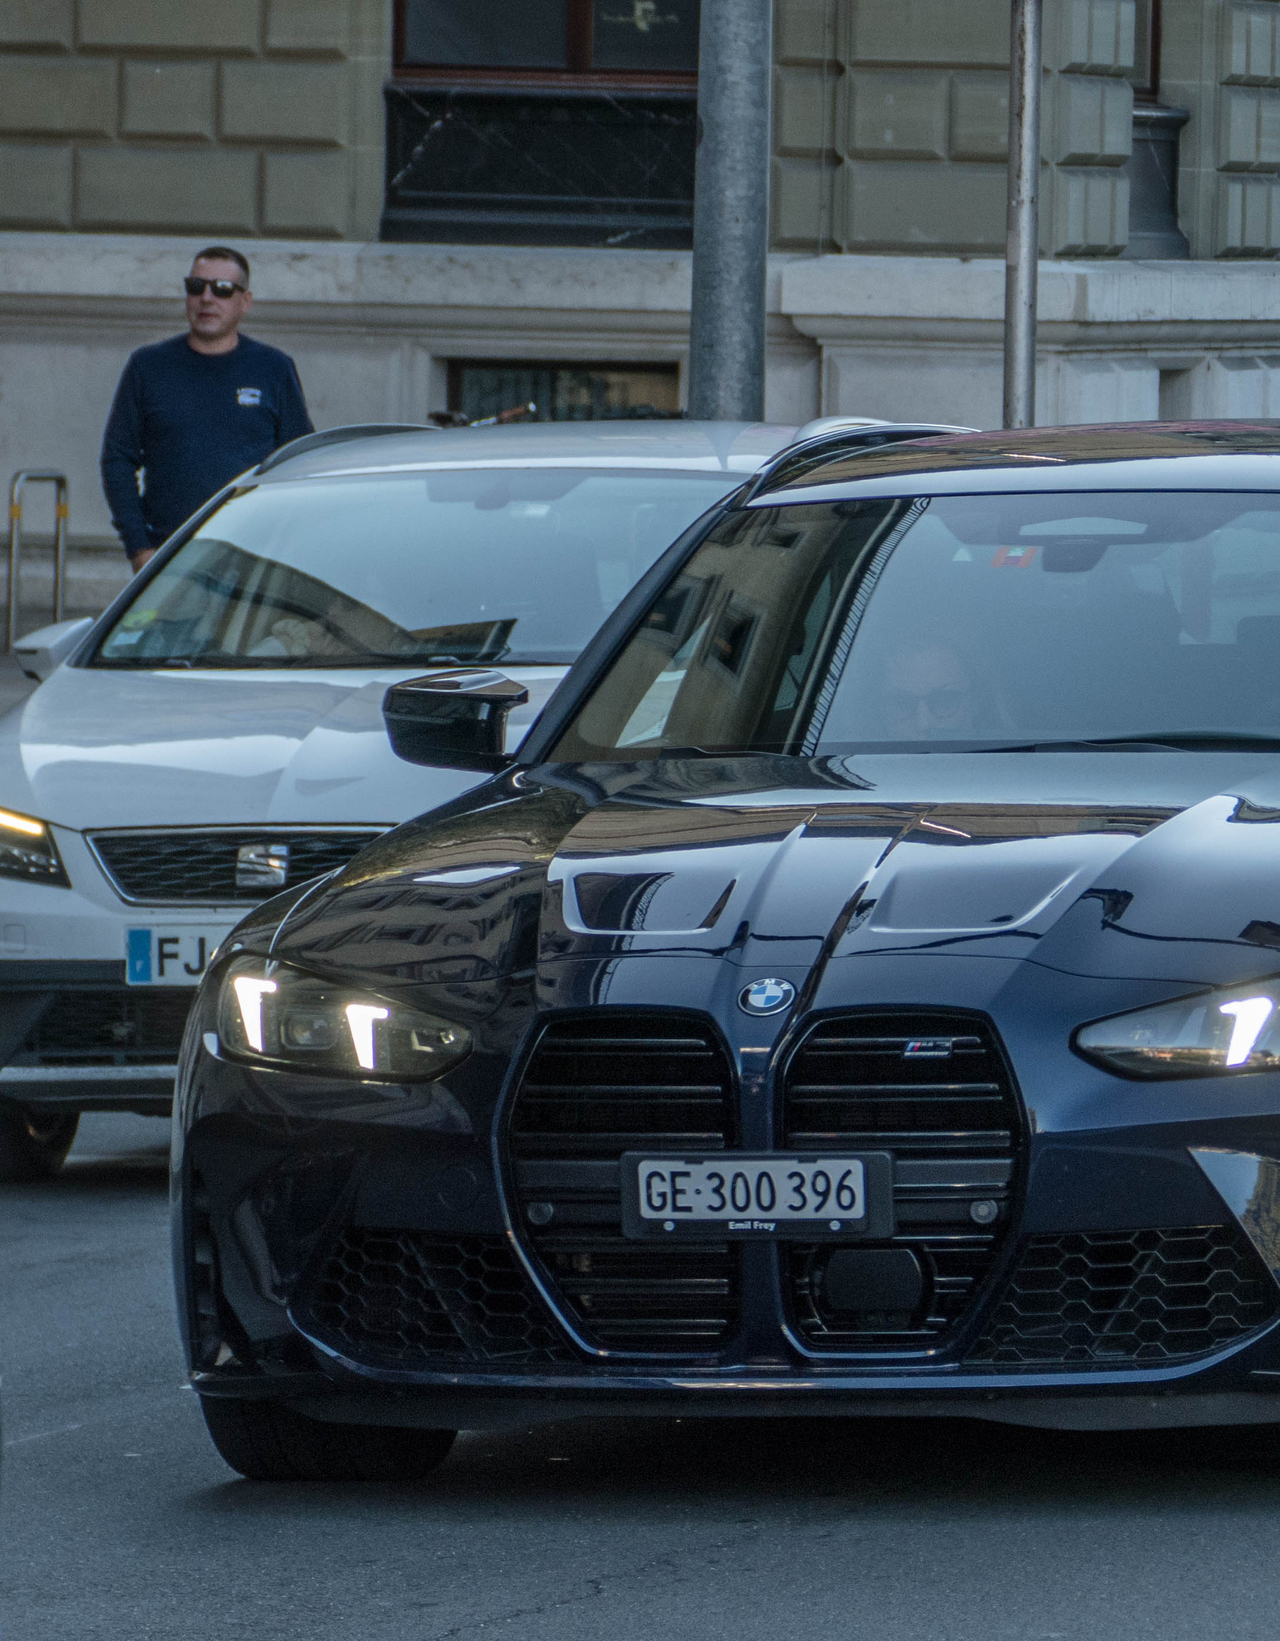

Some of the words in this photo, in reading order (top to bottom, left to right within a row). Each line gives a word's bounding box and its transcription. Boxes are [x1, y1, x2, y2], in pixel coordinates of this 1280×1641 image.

[158, 937, 213, 976] FJ
[787, 1170, 856, 1213] 396
[728, 1221, 751, 1230] Emil
[753, 1221, 776, 1231] Frey
